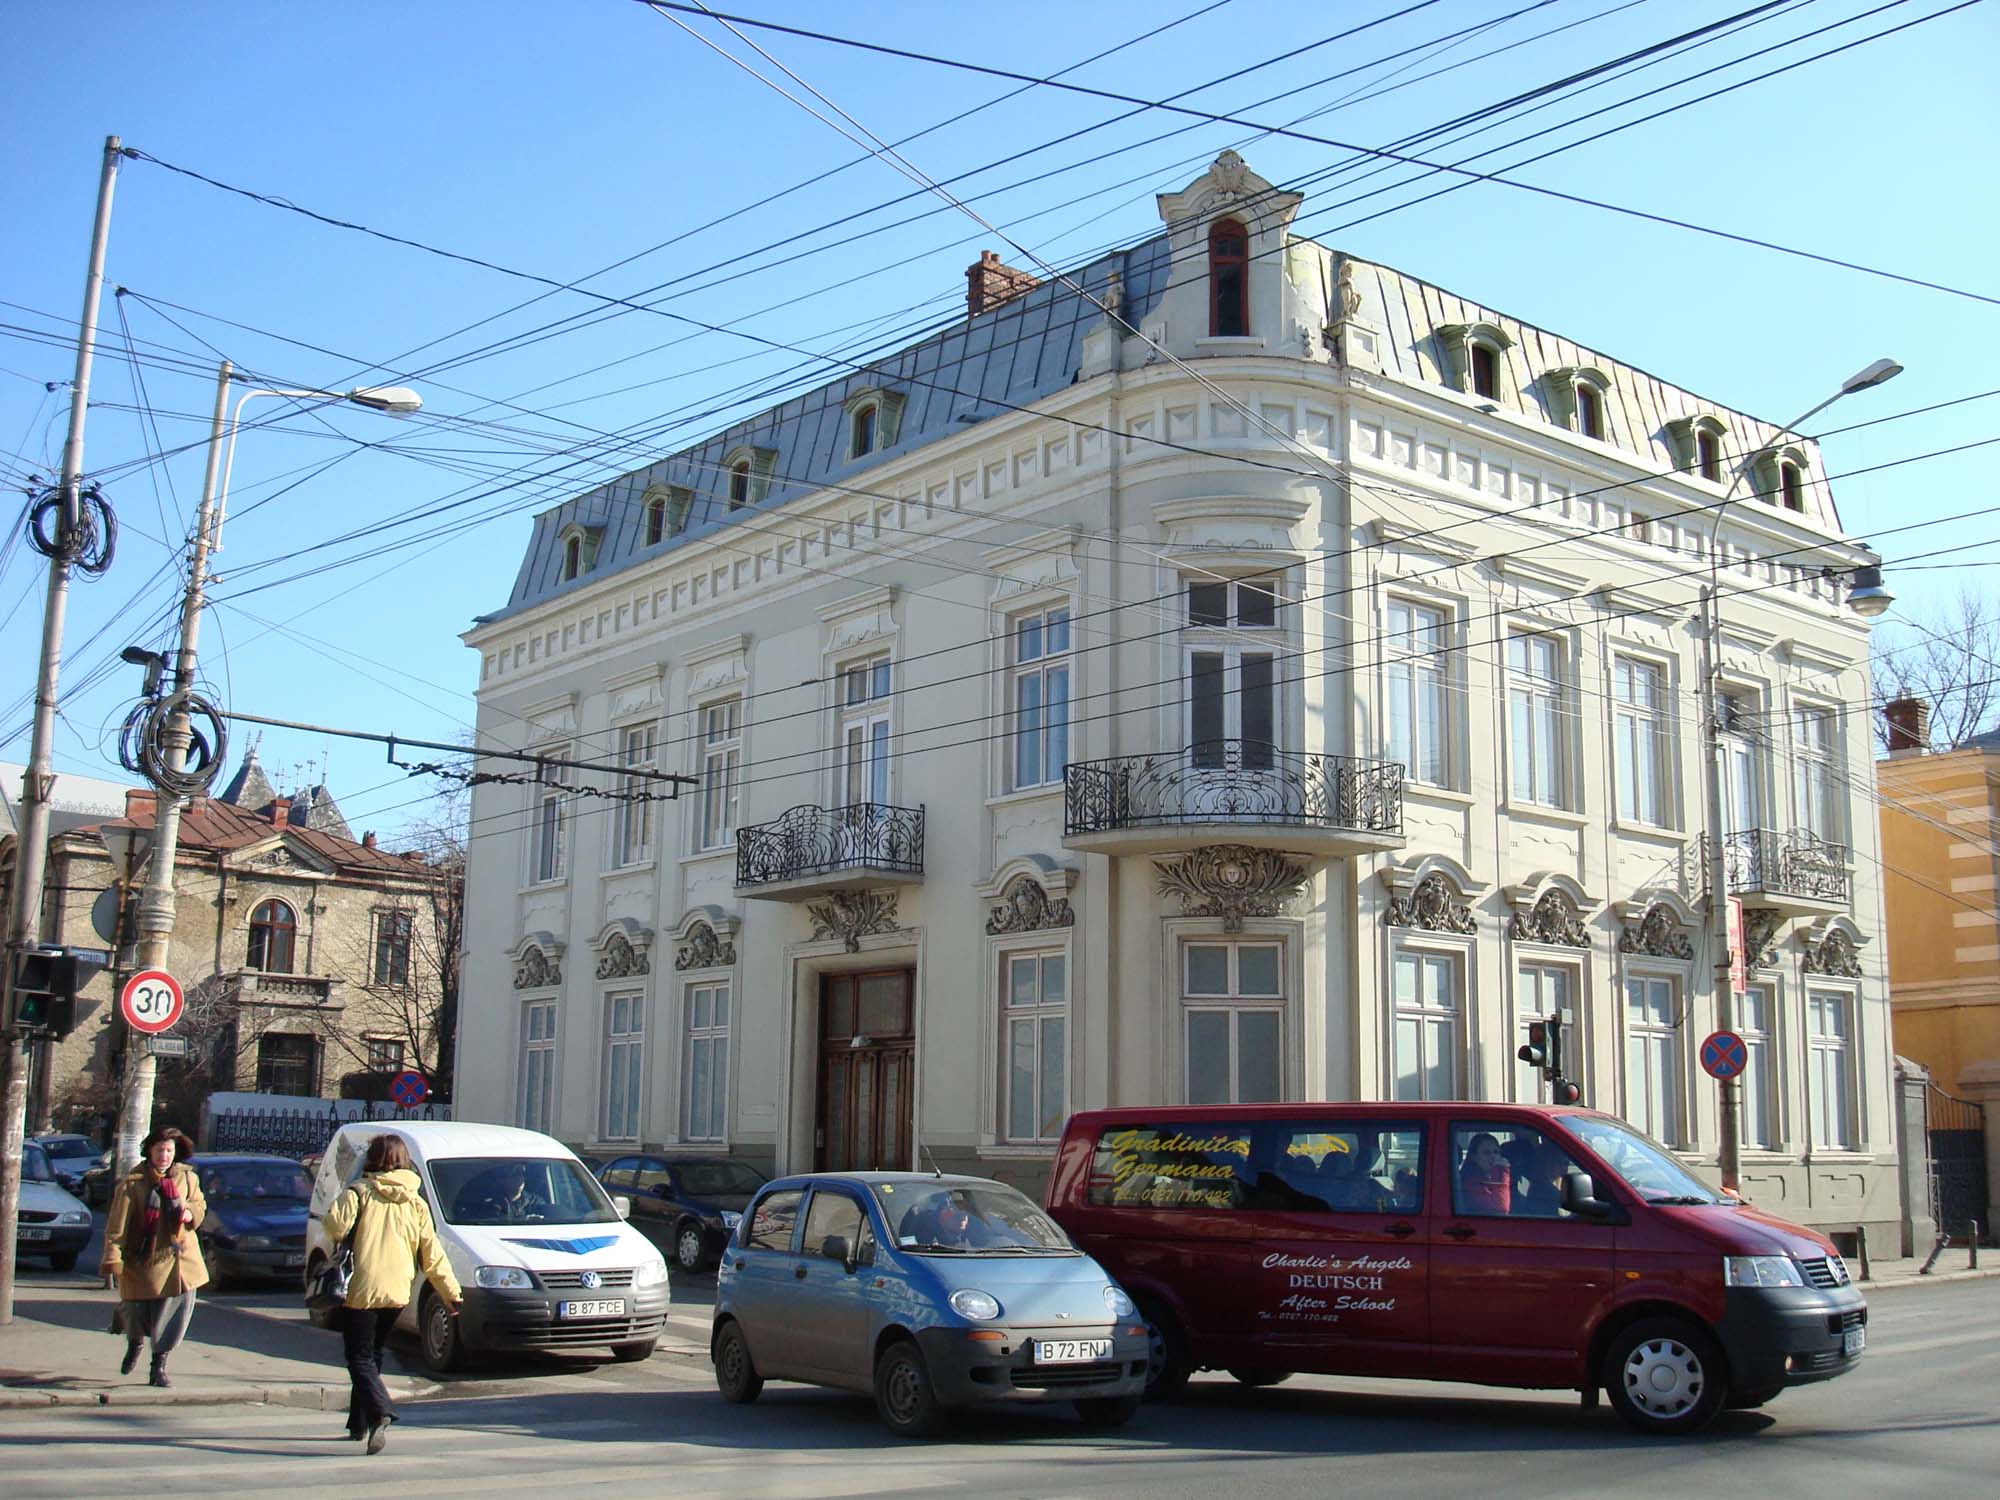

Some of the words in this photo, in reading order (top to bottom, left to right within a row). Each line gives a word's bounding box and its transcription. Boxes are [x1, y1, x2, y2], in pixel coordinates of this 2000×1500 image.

[136, 987, 171, 1016] 30
[1111, 1130, 1243, 1157] Gradinita
[1112, 1154, 1235, 1182] Germana
[1262, 1252, 1343, 1268] Charlie's
[1348, 1255, 1412, 1273] Angels
[1289, 1274, 1384, 1290] DEUTSCH
[568, 1303, 577, 1315] B
[581, 1302, 594, 1314] 87
[598, 1301, 621, 1314] FCE
[1280, 1294, 1328, 1311] After
[1334, 1295, 1396, 1311] School
[1044, 1343, 1054, 1359] B
[1059, 1343, 1075, 1358] 72
[1079, 1342, 1107, 1357] FNJ
